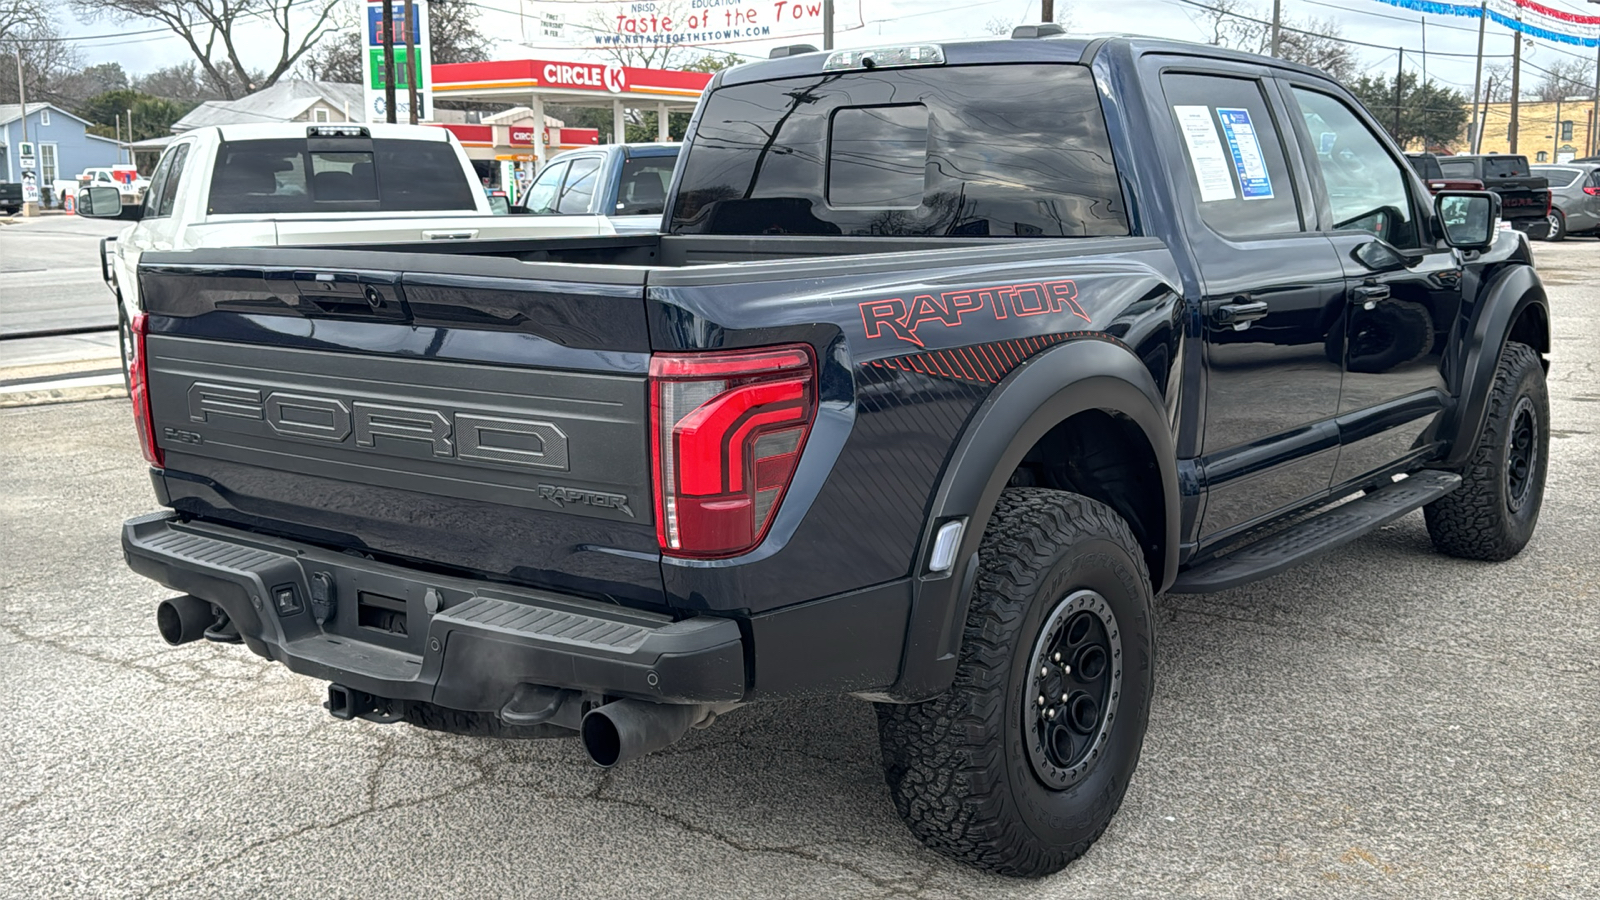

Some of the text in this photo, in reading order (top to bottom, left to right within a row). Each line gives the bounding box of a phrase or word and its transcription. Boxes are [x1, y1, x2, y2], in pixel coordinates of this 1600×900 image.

[616, 0, 822, 33] Taste of the Tow
[631, 3, 656, 13] NBISD
[692, 0, 741, 9] EDUCATION
[595, 26, 770, 44] WWW.NBTASTEOFTHETOWN.COM
[543, 64, 625, 91] CIRCLE K
[858, 279, 1092, 347] RAPTOR
[187, 380, 570, 472] FORD
[537, 483, 637, 518] RAPTOR
